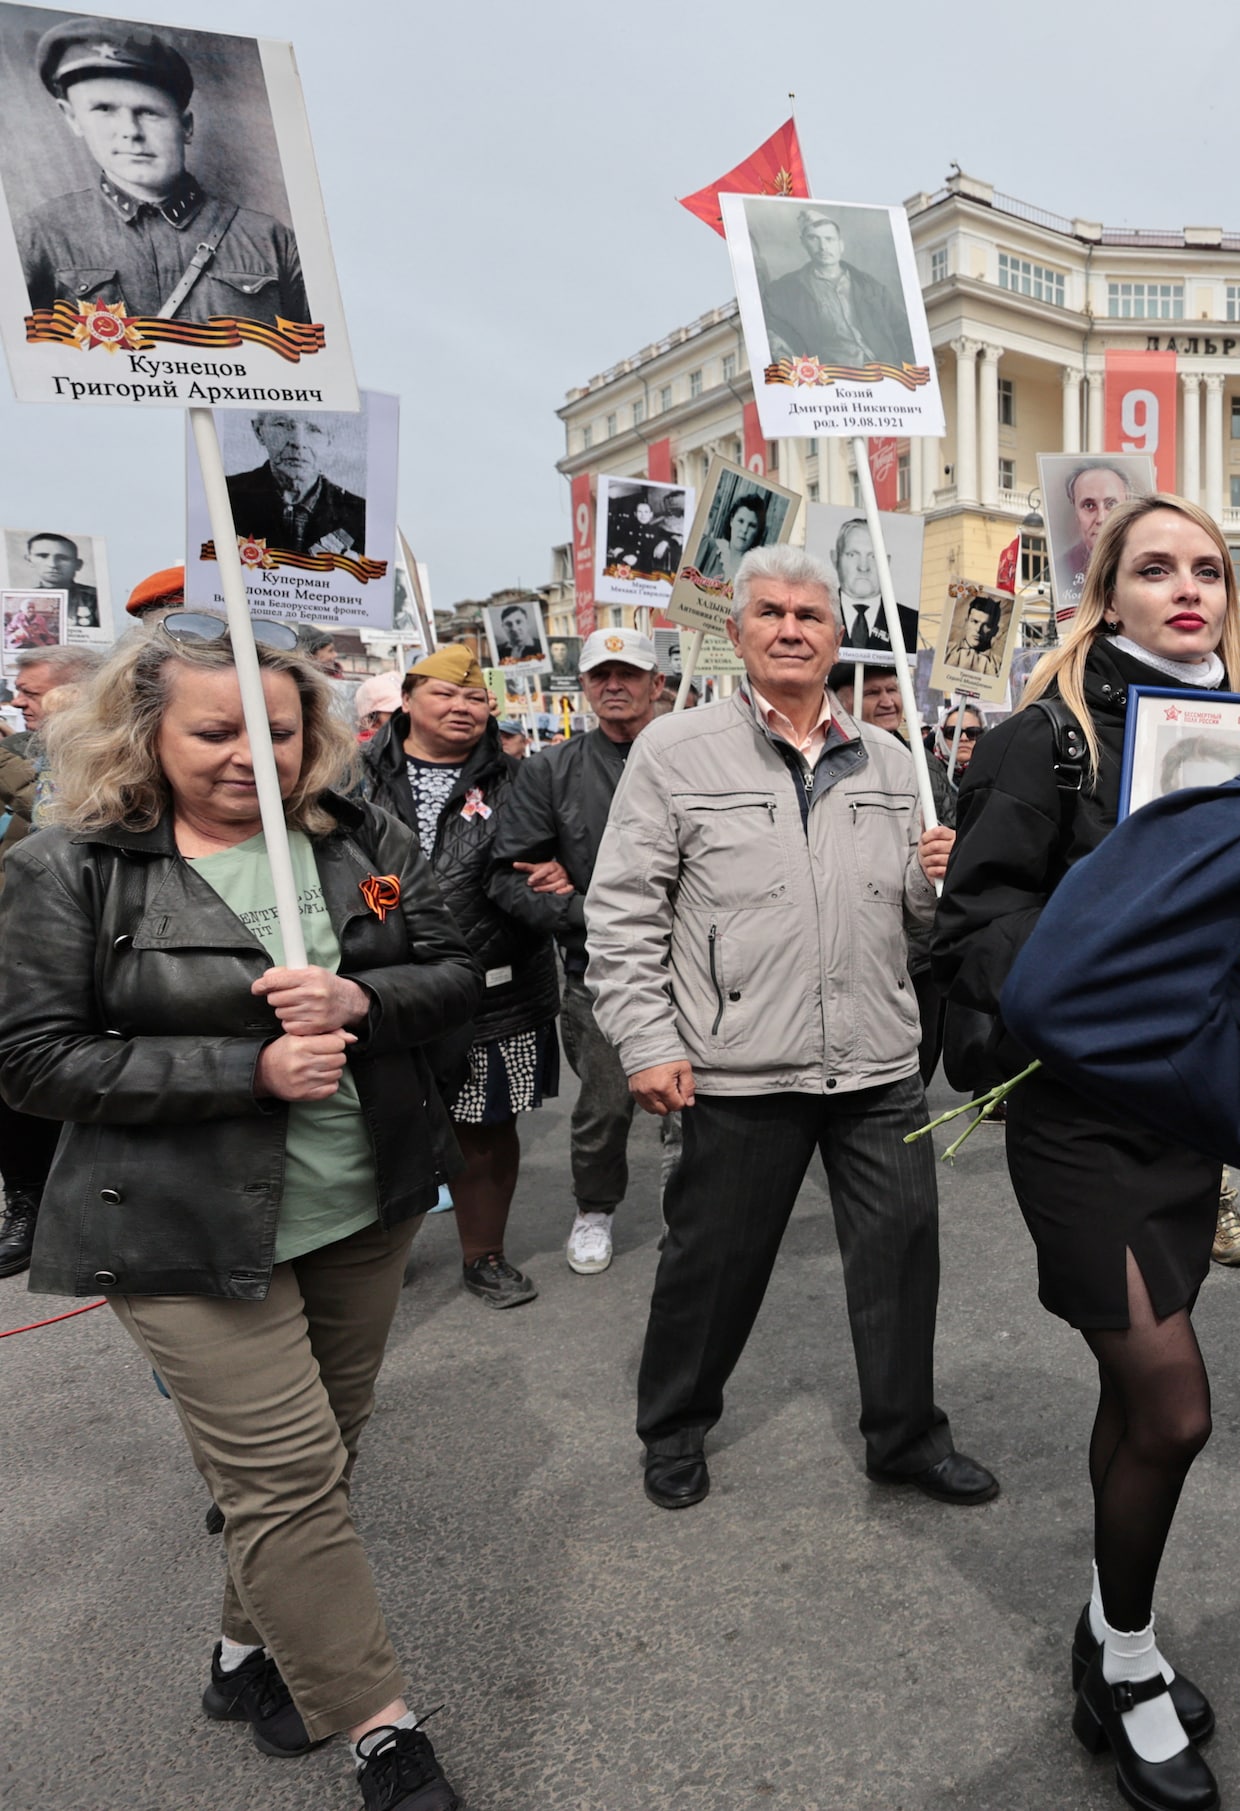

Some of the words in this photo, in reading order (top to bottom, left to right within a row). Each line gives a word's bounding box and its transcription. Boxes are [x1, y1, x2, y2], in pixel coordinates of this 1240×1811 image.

[129, 354, 247, 378] Кузнецов
[52, 376, 179, 401] Григорий
[187, 381, 324, 403] Архипович
[835, 388, 874, 399] Козий
[788, 403, 849, 416] Дмитрий
[852, 403, 923, 415] Никитович
[813, 418, 839, 431] род.
[843, 417, 904, 428] 19.08.1921
[1121, 389, 1159, 456] 9
[576, 503, 590, 547] 9
[262, 571, 330, 588] Куперман
[246, 586, 290, 598] ломон
[295, 588, 362, 606] Меерович
[253, 599, 266, 607] на
[269, 599, 331, 615] Белорусском
[333, 606, 369, 617] фронте,
[300, 611, 339, 622] Берлина
